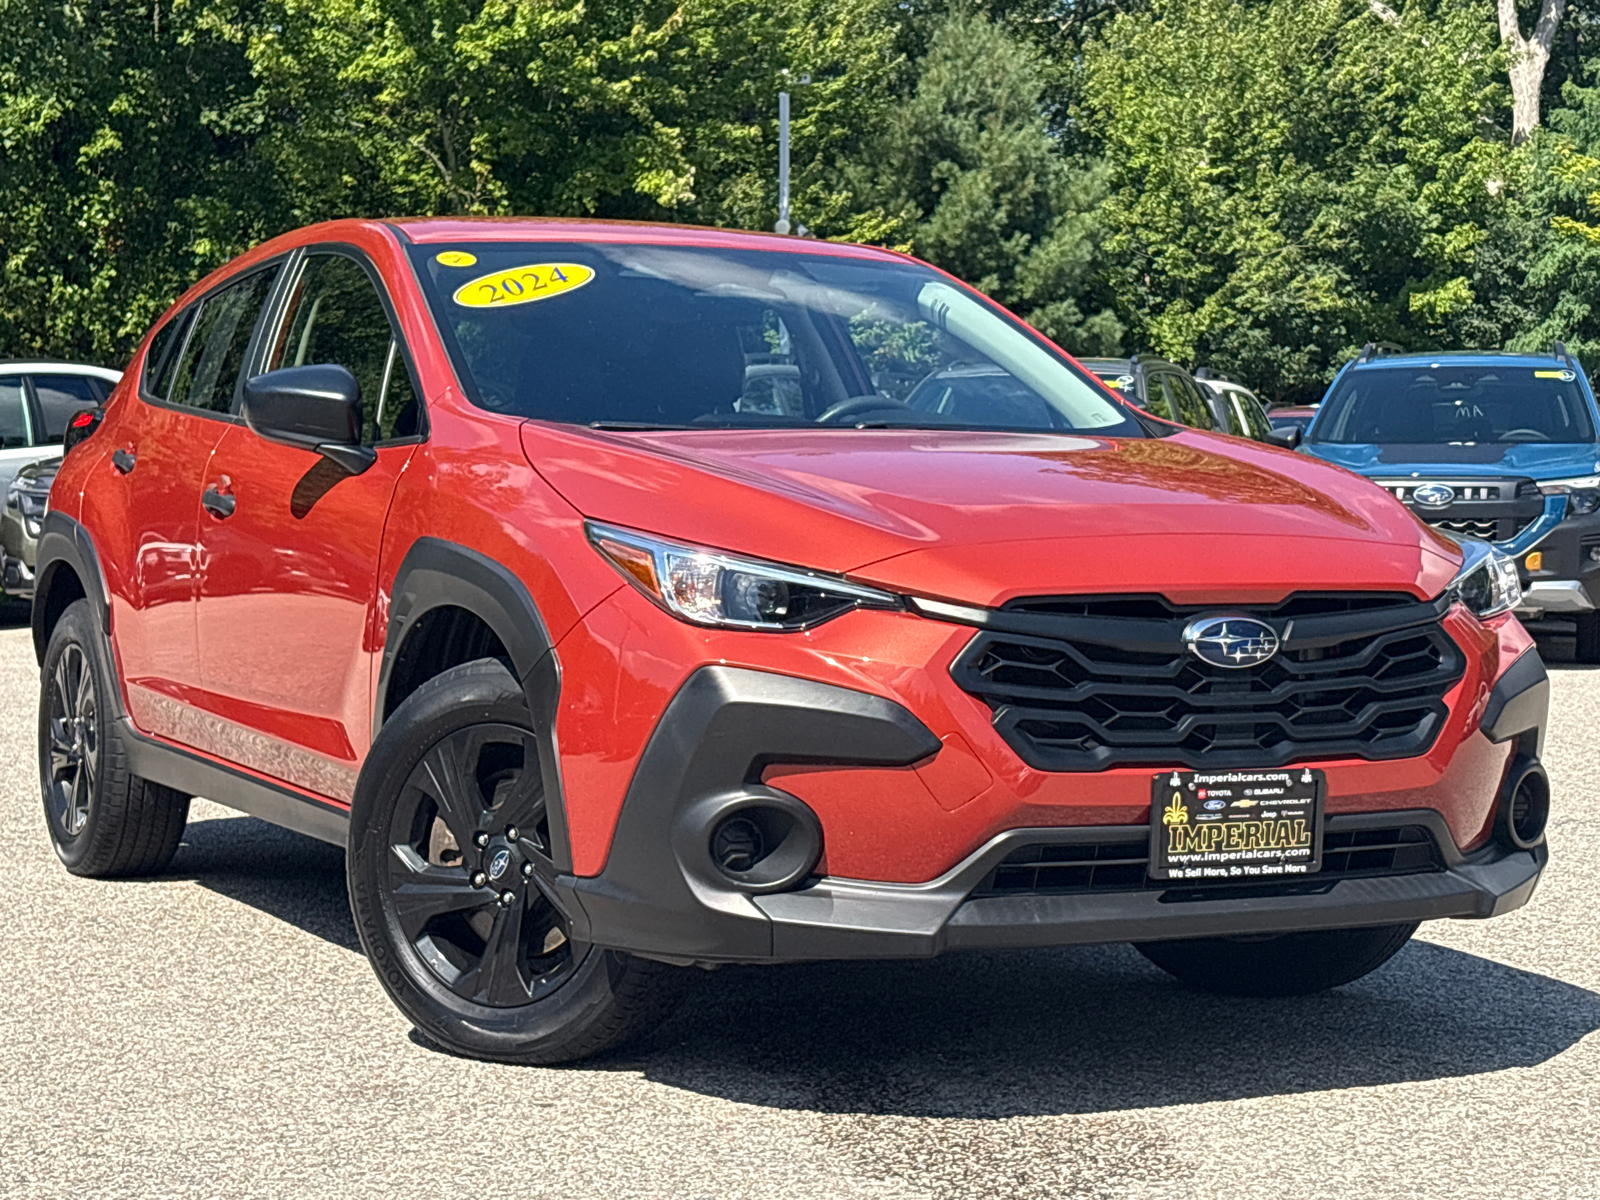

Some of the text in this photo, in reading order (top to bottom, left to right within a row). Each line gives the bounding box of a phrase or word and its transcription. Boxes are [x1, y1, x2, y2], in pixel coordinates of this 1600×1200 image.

[478, 266, 569, 304] 2024
[1455, 404, 1484, 418] MA
[1194, 772, 1289, 785] Imperialcars.com
[1207, 789, 1232, 797] TOYOTA
[1254, 788, 1284, 796] SUBARU
[1259, 798, 1312, 806] CHEVROLET
[1260, 810, 1278, 819] Jeep
[1167, 819, 1311, 853] IMPERIAL
[1167, 848, 1310, 863] www.imperialcars.com
[1168, 863, 1307, 878] We Sell More, So You Save More
[355, 881, 407, 996] YOKOHAMA
